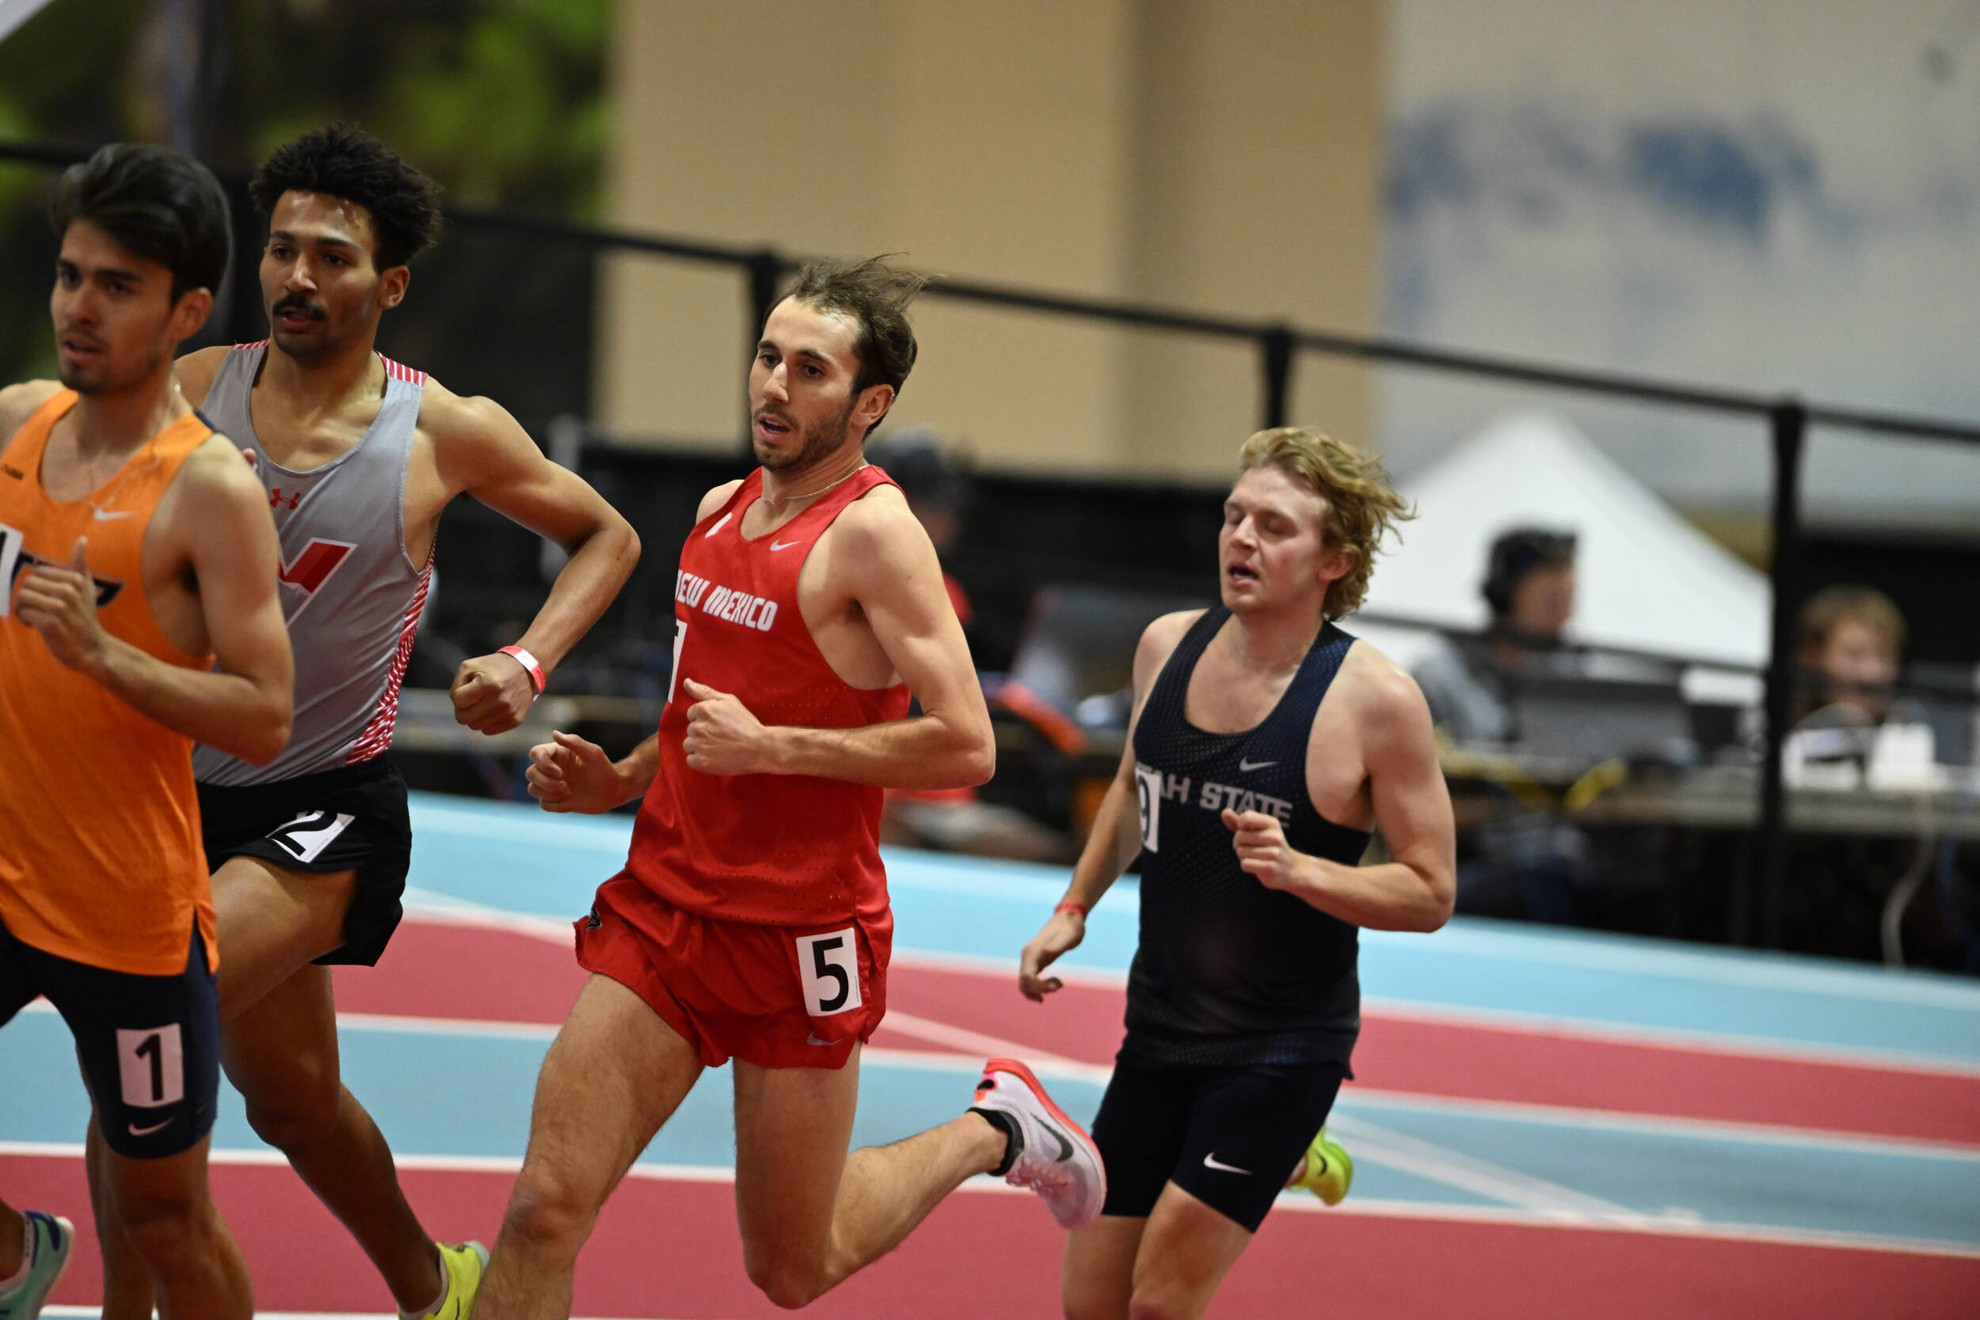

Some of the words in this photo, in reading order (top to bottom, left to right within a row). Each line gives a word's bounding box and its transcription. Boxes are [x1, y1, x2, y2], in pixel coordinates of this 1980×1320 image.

[702, 585, 778, 631] MEXICO
[1199, 782, 1293, 828] STATE
[265, 809, 338, 857] 2
[812, 936, 849, 1012] 5
[135, 1033, 164, 1101] 1
